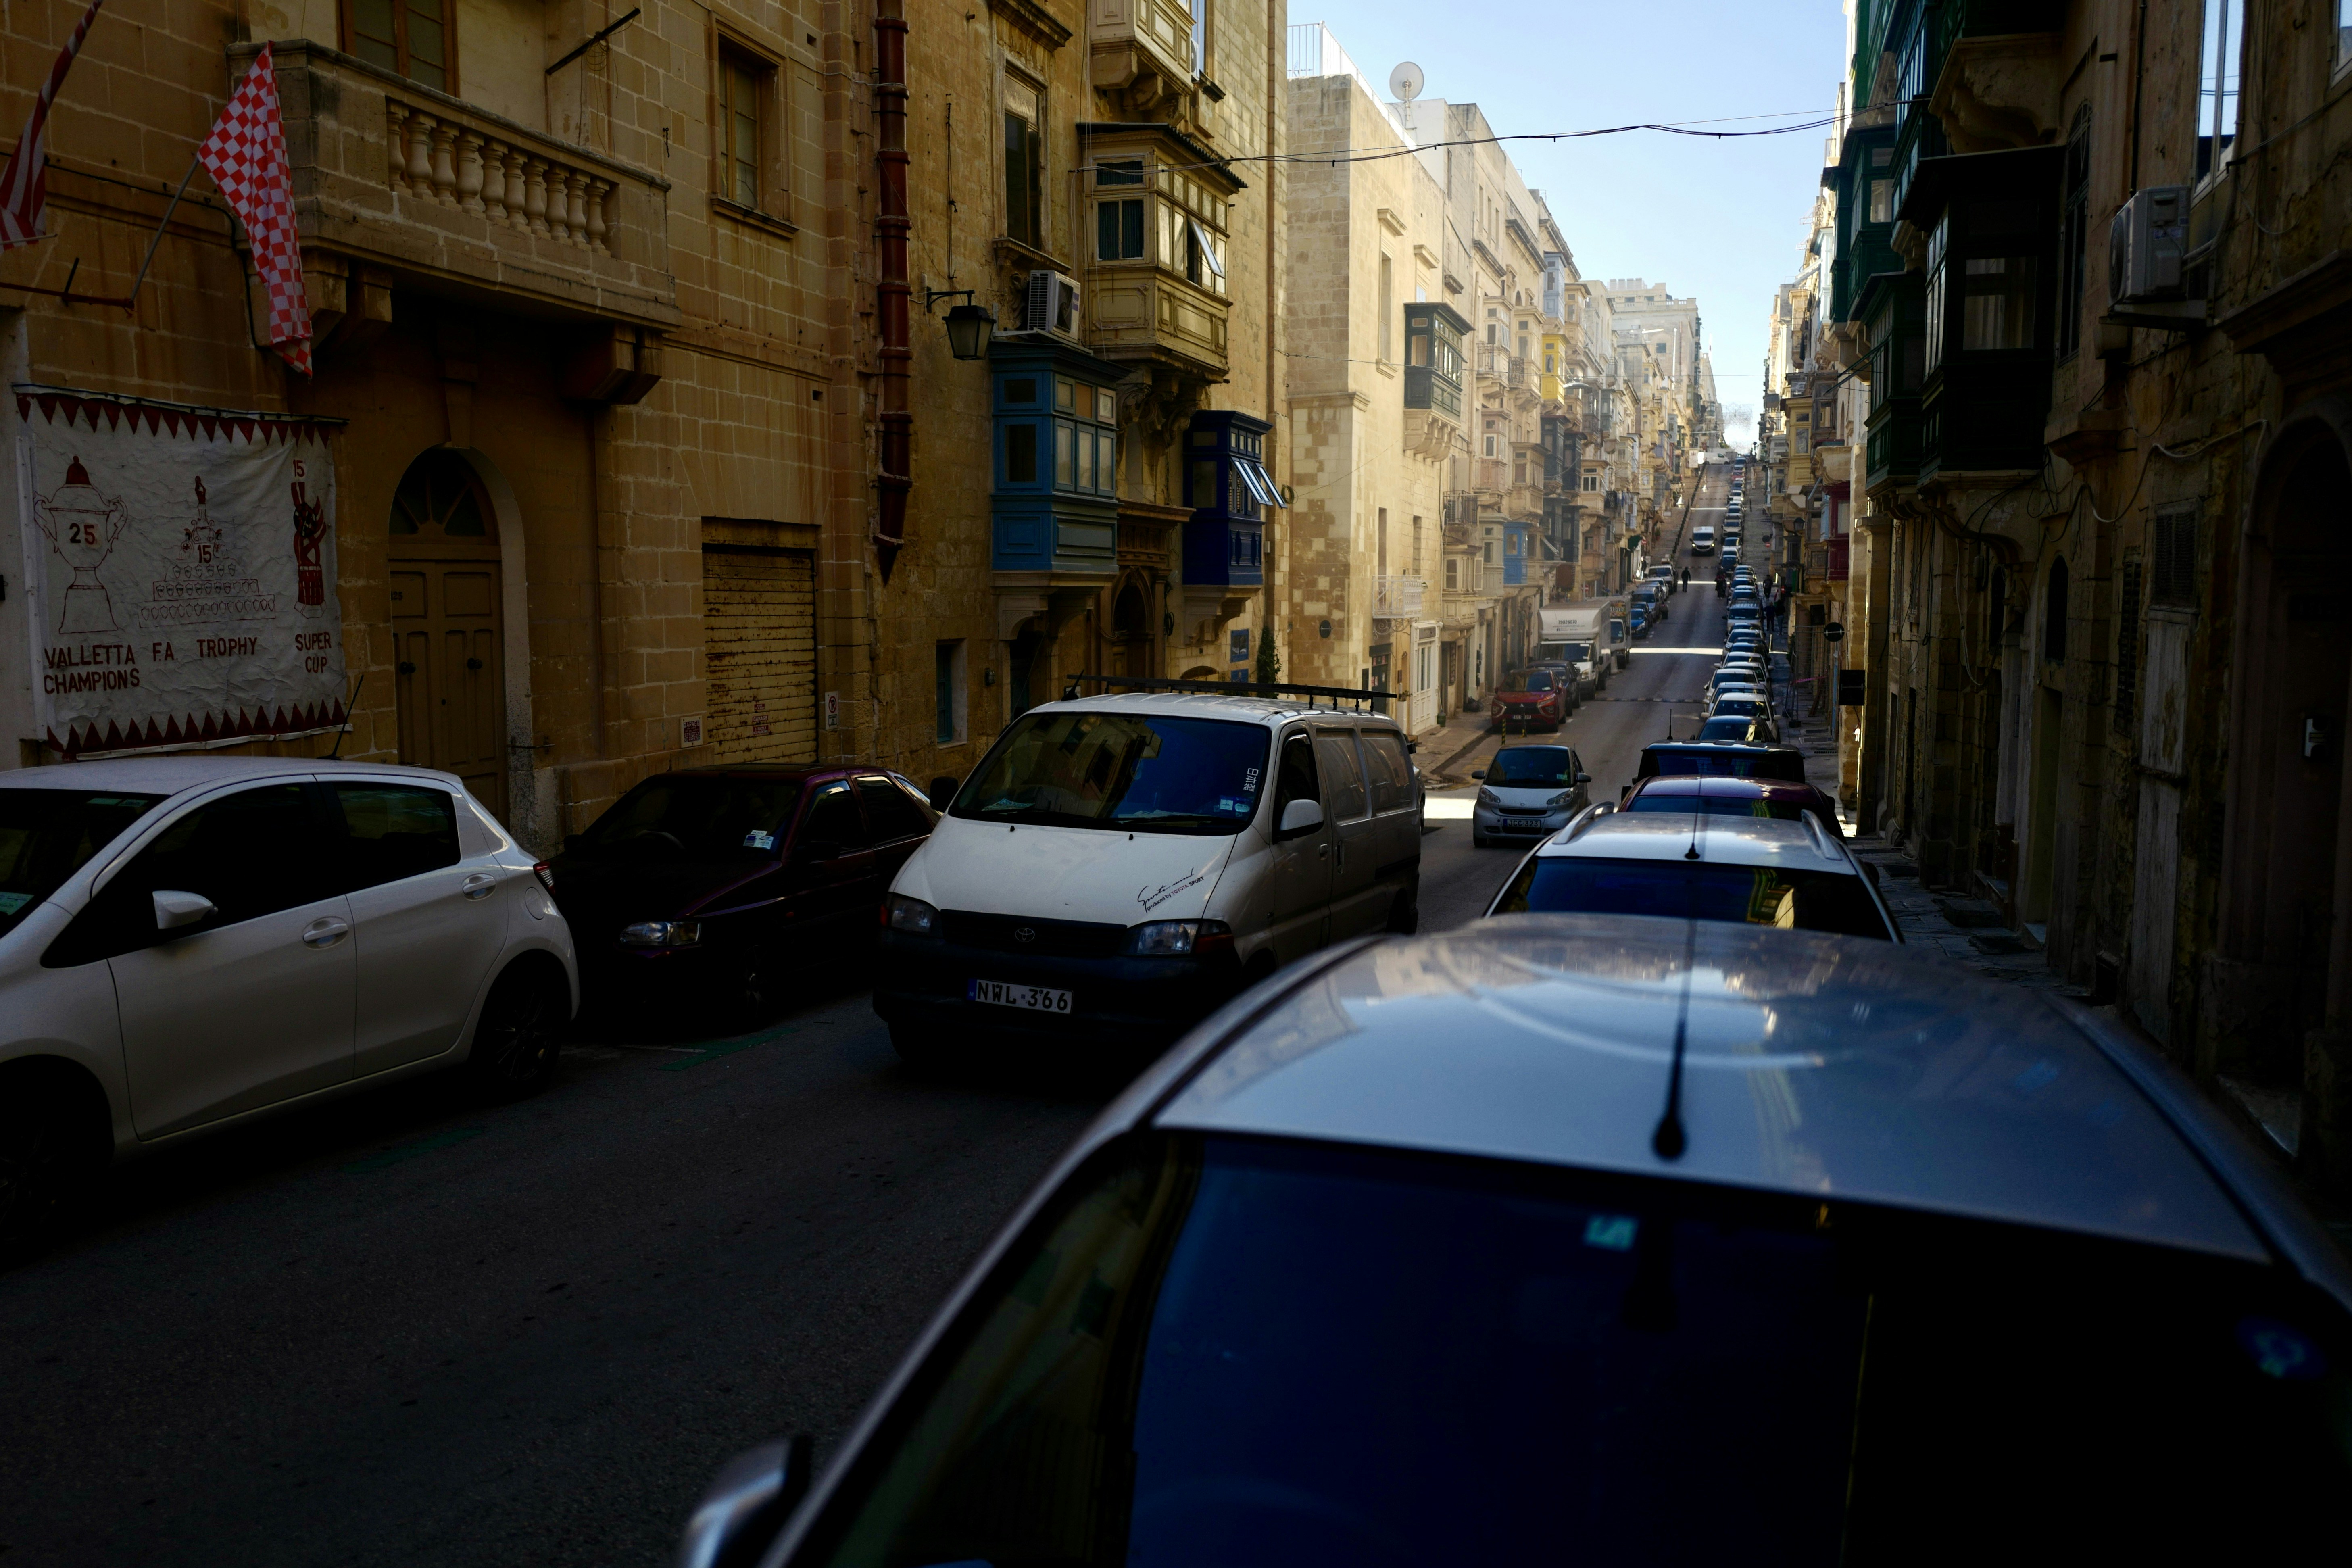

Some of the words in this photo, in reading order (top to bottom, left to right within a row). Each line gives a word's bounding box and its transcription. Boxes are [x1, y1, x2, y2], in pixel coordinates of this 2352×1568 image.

[293, 459, 304, 477] 15
[69, 523, 95, 545] 25
[198, 545, 211, 563] 15
[152, 642, 178, 661] F.A.
[197, 637, 257, 657] TROPHY
[295, 632, 332, 651] SUPER
[44, 644, 136, 669] VALLETTA
[305, 657, 327, 673] CUP
[44, 668, 140, 694] CHAMPIONS
[1147, 896, 1166, 911] produced
[1171, 884, 1189, 895] TOYOTA
[1189, 876, 1204, 886] SPORT
[978, 982, 1016, 1004] NWL
[1028, 988, 1068, 1011] 366
